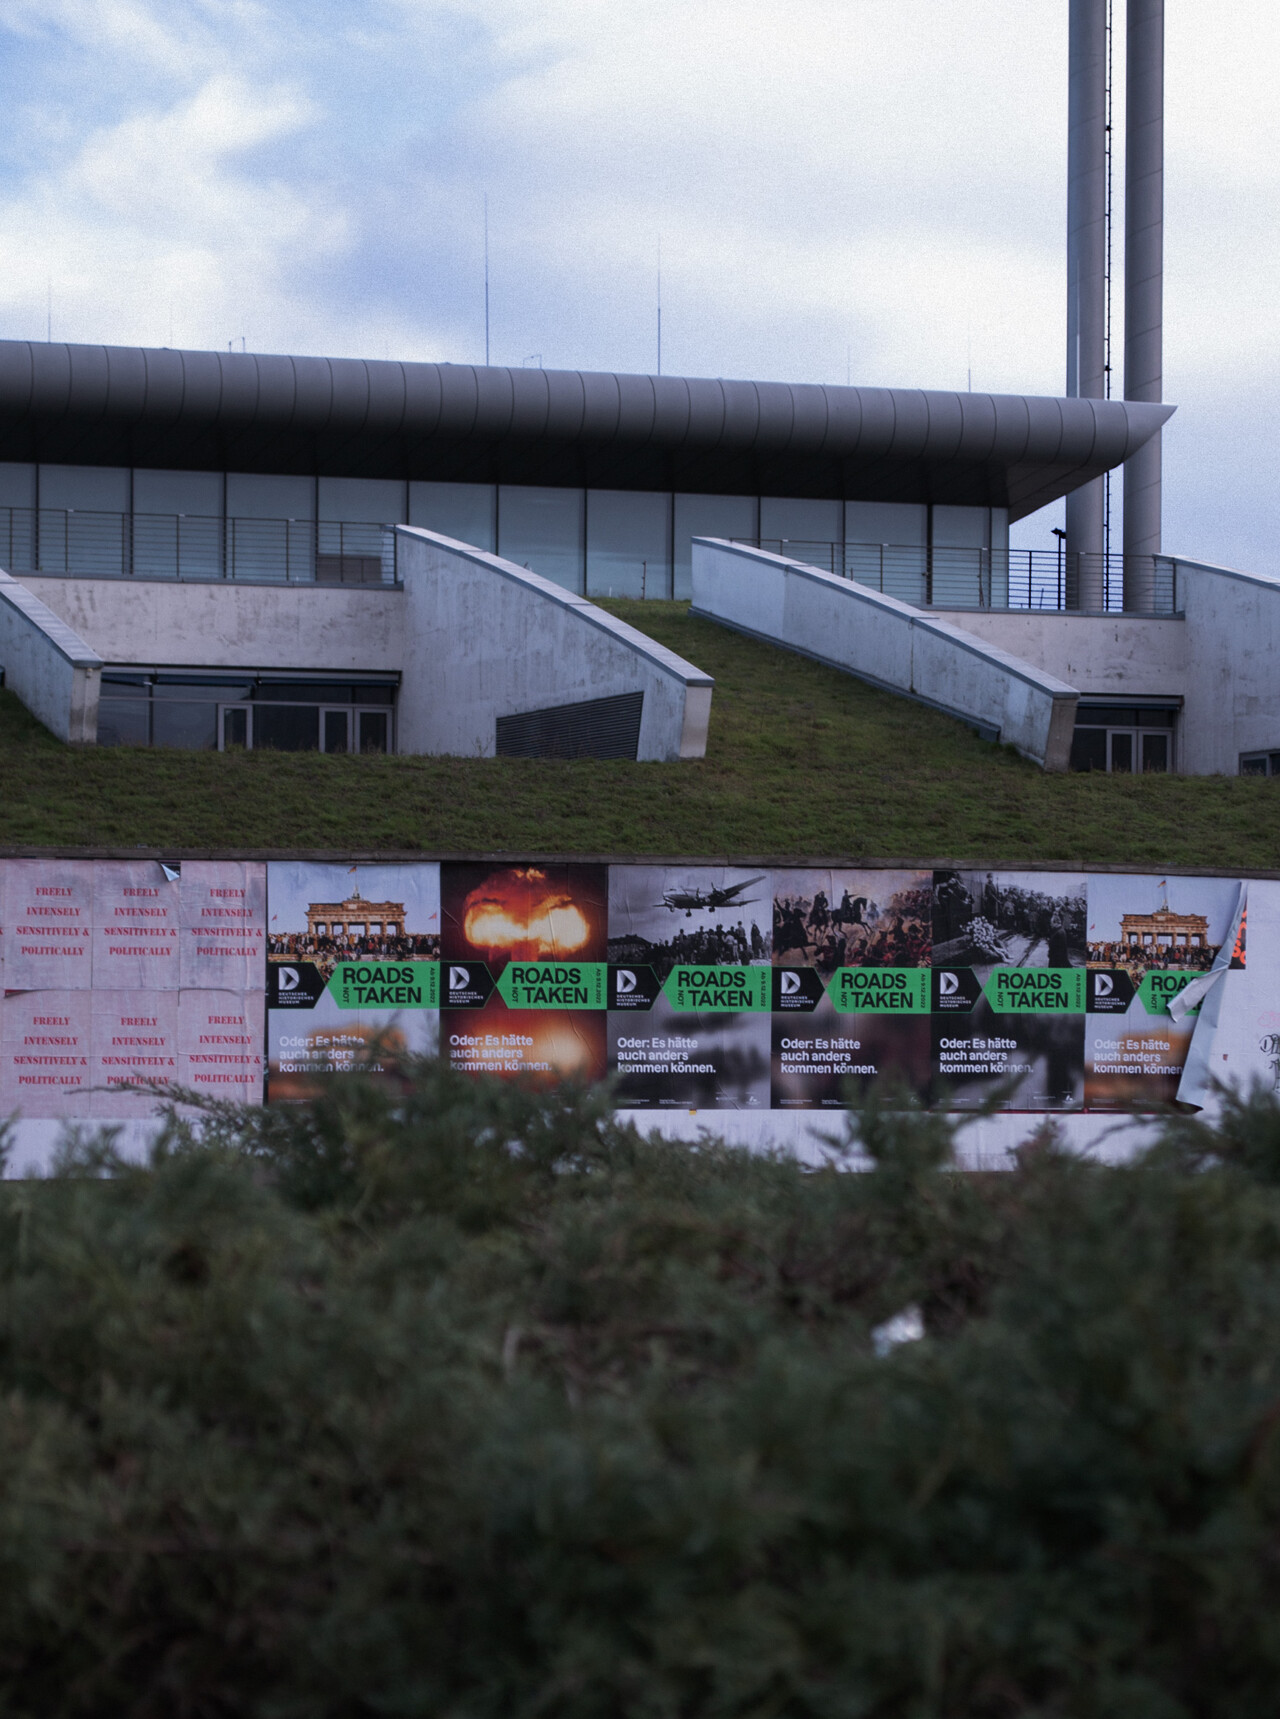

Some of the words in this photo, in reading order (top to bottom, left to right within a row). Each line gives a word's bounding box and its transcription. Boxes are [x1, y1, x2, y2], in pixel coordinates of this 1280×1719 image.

[36, 888, 72, 896] FREELY
[123, 888, 159, 897] FREELY
[210, 889, 246, 897] FREELY
[26, 907, 80, 916] INTENSELY
[114, 908, 167, 917] INTENSELY
[201, 908, 253, 917] INTENSELY
[16, 927, 79, 936] SENSITIVELY
[83, 928, 89, 936] &
[104, 928, 167, 936] SENSITIVELY
[170, 928, 176, 936] &
[192, 928, 252, 937] SENSITIVELY
[256, 929, 262, 937] &
[21, 946, 84, 955] POLITICALLY
[109, 947, 170, 956] POLITICALLY
[197, 947, 257, 956] POLITICALLY
[343, 967, 414, 984] ROADS
[512, 968, 581, 984] ROADS
[678, 971, 746, 987] ROADS
[841, 973, 907, 989] ROADS
[997, 973, 1062, 989] ROADS
[1152, 976, 1198, 991] ROA
[354, 987, 421, 1003] TAKEN
[522, 987, 588, 1003] TAKEN
[688, 990, 753, 1006] TAKEN
[851, 992, 913, 1008] TAKEN
[1007, 992, 1068, 1008] TAKEN
[33, 1017, 70, 1025] FREELY
[121, 1018, 157, 1026] FREELY
[208, 1016, 244, 1025] FREELY
[24, 1037, 78, 1045] INTENSELY
[112, 1037, 165, 1046] INTENSELY
[200, 1035, 251, 1044] INTENSELY
[279, 1036, 313, 1046] Oder:
[316, 1036, 329, 1046] Es
[450, 1035, 483, 1046] Oder:
[485, 1036, 499, 1046] Es
[502, 1034, 533, 1046] hätte
[617, 1037, 649, 1048] Oder:
[652, 1038, 666, 1048] Es
[668, 1037, 698, 1048] hätte
[781, 1038, 813, 1049] Oder:
[815, 1039, 829, 1049] Es
[831, 1038, 860, 1049] hätte
[940, 1038, 970, 1048] Oder:
[973, 1039, 986, 1049] Es
[988, 1037, 1017, 1049] hätte
[1095, 1039, 1125, 1049] Oder:
[1127, 1040, 1139, 1050] Es
[1141, 1039, 1170, 1050] hätte
[279, 1049, 309, 1059] auch
[450, 1049, 479, 1058] auch
[482, 1049, 523, 1058] anders
[617, 1051, 646, 1060] auch
[648, 1051, 688, 1060] anders
[781, 1051, 809, 1061] auch
[812, 1051, 851, 1061] anders
[940, 1051, 967, 1060] auch
[969, 1051, 1007, 1061] anders
[1094, 1052, 1120, 1061] auch
[1123, 1052, 1160, 1062] anders
[14, 1056, 77, 1065] SENSITIVELY
[102, 1057, 165, 1066] SENSITIVELY
[168, 1058, 175, 1066] &
[189, 1055, 250, 1064] SENSITIVELY
[254, 1056, 261, 1064] &
[450, 1061, 502, 1071] kommen
[504, 1060, 552, 1071] können.
[617, 1063, 669, 1073] kommen
[671, 1062, 716, 1073] können.
[781, 1063, 831, 1073] kommen
[833, 1062, 878, 1074] können.
[940, 1063, 988, 1073] kommen
[990, 1062, 1034, 1073] können.
[1094, 1063, 1141, 1073] kommen
[19, 1076, 81, 1085] POLITICALLY
[194, 1074, 255, 1083] POLITICALLY
